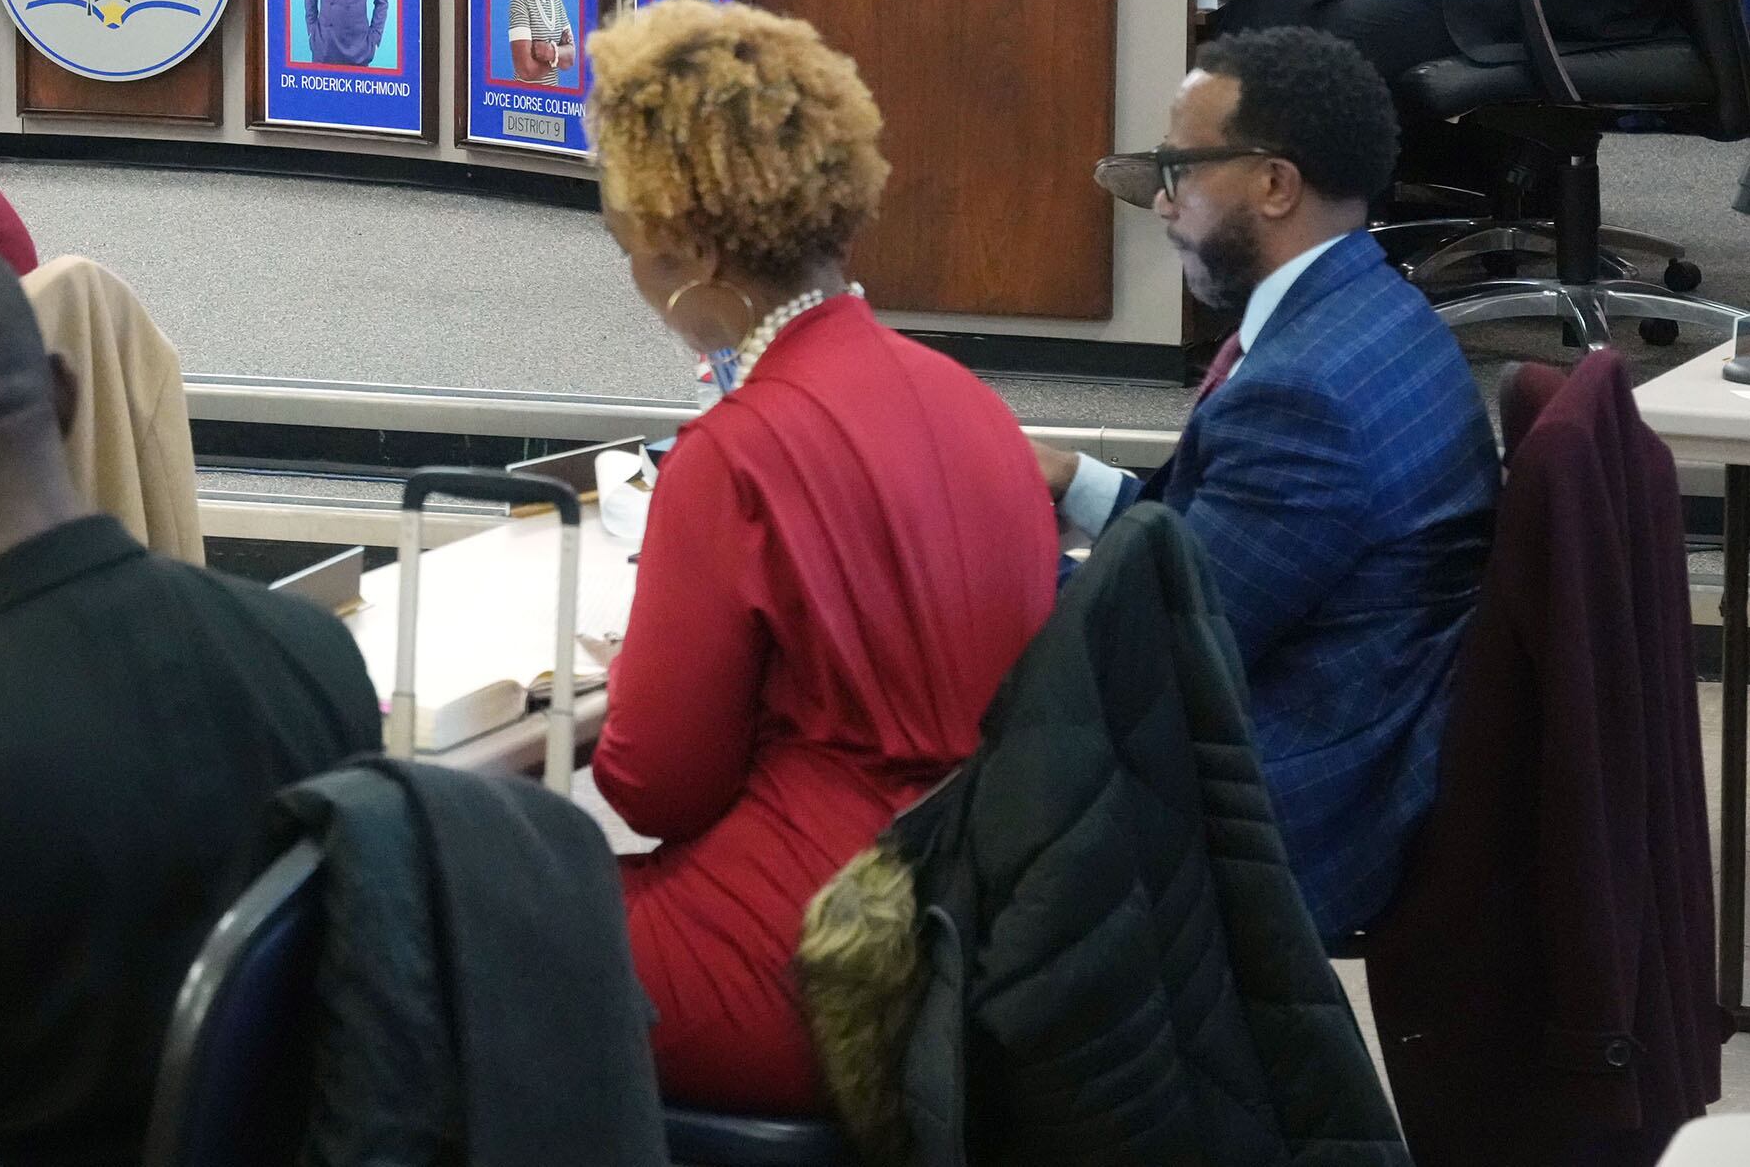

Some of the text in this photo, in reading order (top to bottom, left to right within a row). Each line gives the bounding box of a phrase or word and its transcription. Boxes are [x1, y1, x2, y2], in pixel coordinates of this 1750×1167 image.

[281, 74, 410, 97] DR. RODERICK RICHMOND
[483, 92, 587, 117] JOYCE DORSE COLEMAN
[507, 115, 561, 137] DISTRICT 9
